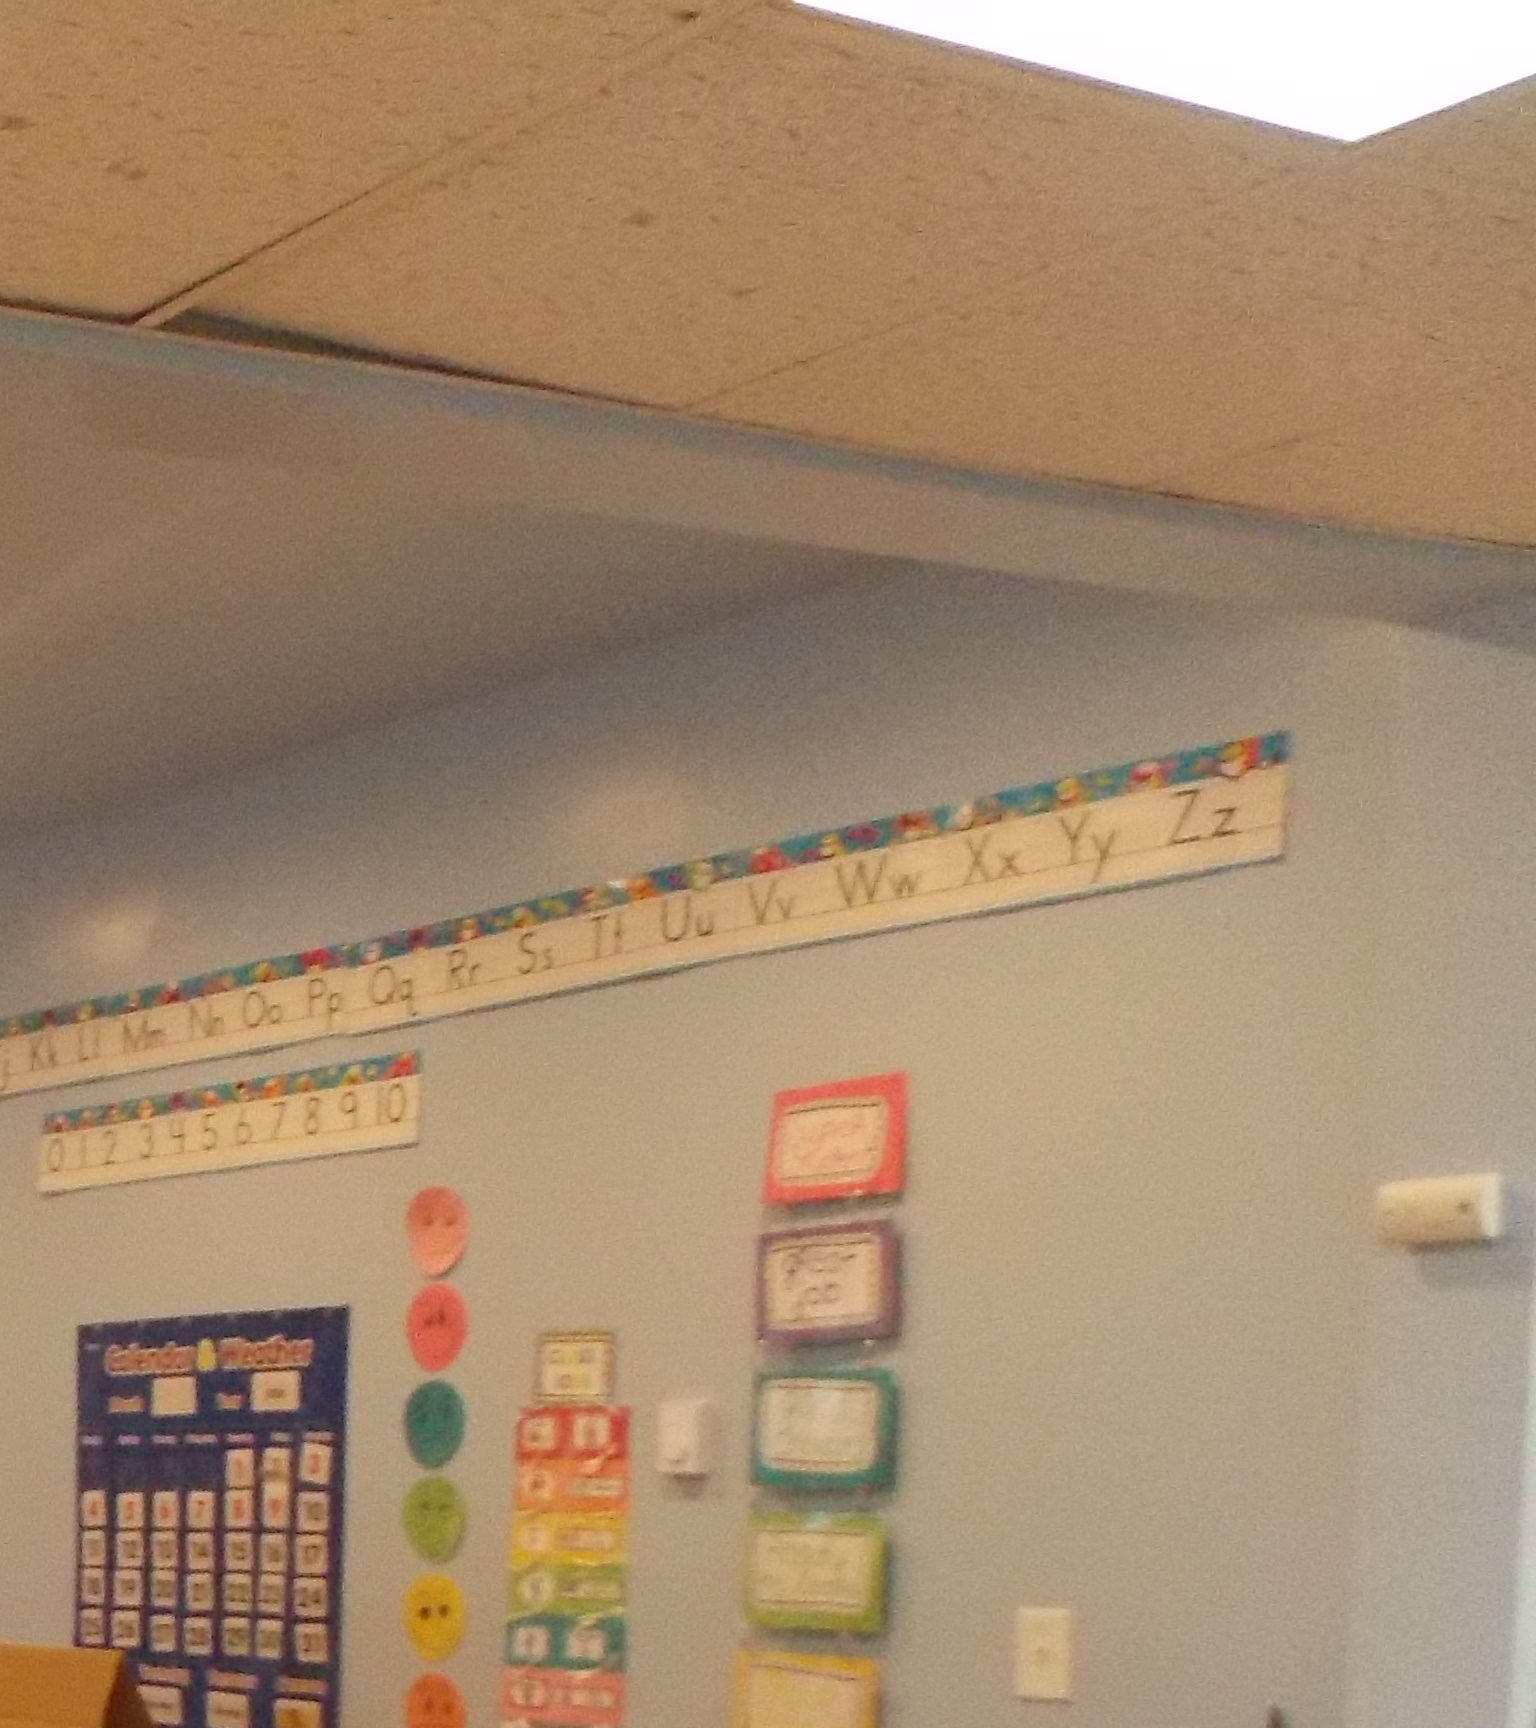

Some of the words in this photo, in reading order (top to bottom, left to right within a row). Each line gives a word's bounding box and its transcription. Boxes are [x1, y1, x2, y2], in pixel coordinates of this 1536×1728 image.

[29, 1034, 57, 1070] Kk
[78, 1026, 100, 1062] Ll
[122, 1019, 167, 1053] Mm
[188, 1001, 225, 1041] Nn
[243, 990, 284, 1029] Oo
[307, 976, 343, 1025] Pp
[370, 964, 418, 1017] Qq
[445, 947, 482, 991] Rr
[516, 931, 557, 975] Ss
[589, 912, 625, 962] Tt
[661, 897, 717, 943] Uu
[747, 879, 799, 926] Vv
[834, 854, 921, 907] Ww
[962, 832, 1026, 886] Xx
[1057, 810, 1117, 884] Yy
[1167, 788, 1241, 845] Zz
[46, 1136, 65, 1173] 0
[102, 1130, 117, 1166] 2
[138, 1121, 155, 1158] 3
[168, 1117, 188, 1154] 4
[201, 1111, 218, 1151] 5
[234, 1108, 253, 1146] 6
[269, 1100, 287, 1140] 7
[303, 1095, 321, 1136] 8
[339, 1089, 359, 1131] 9
[374, 1082, 408, 1124] 10
